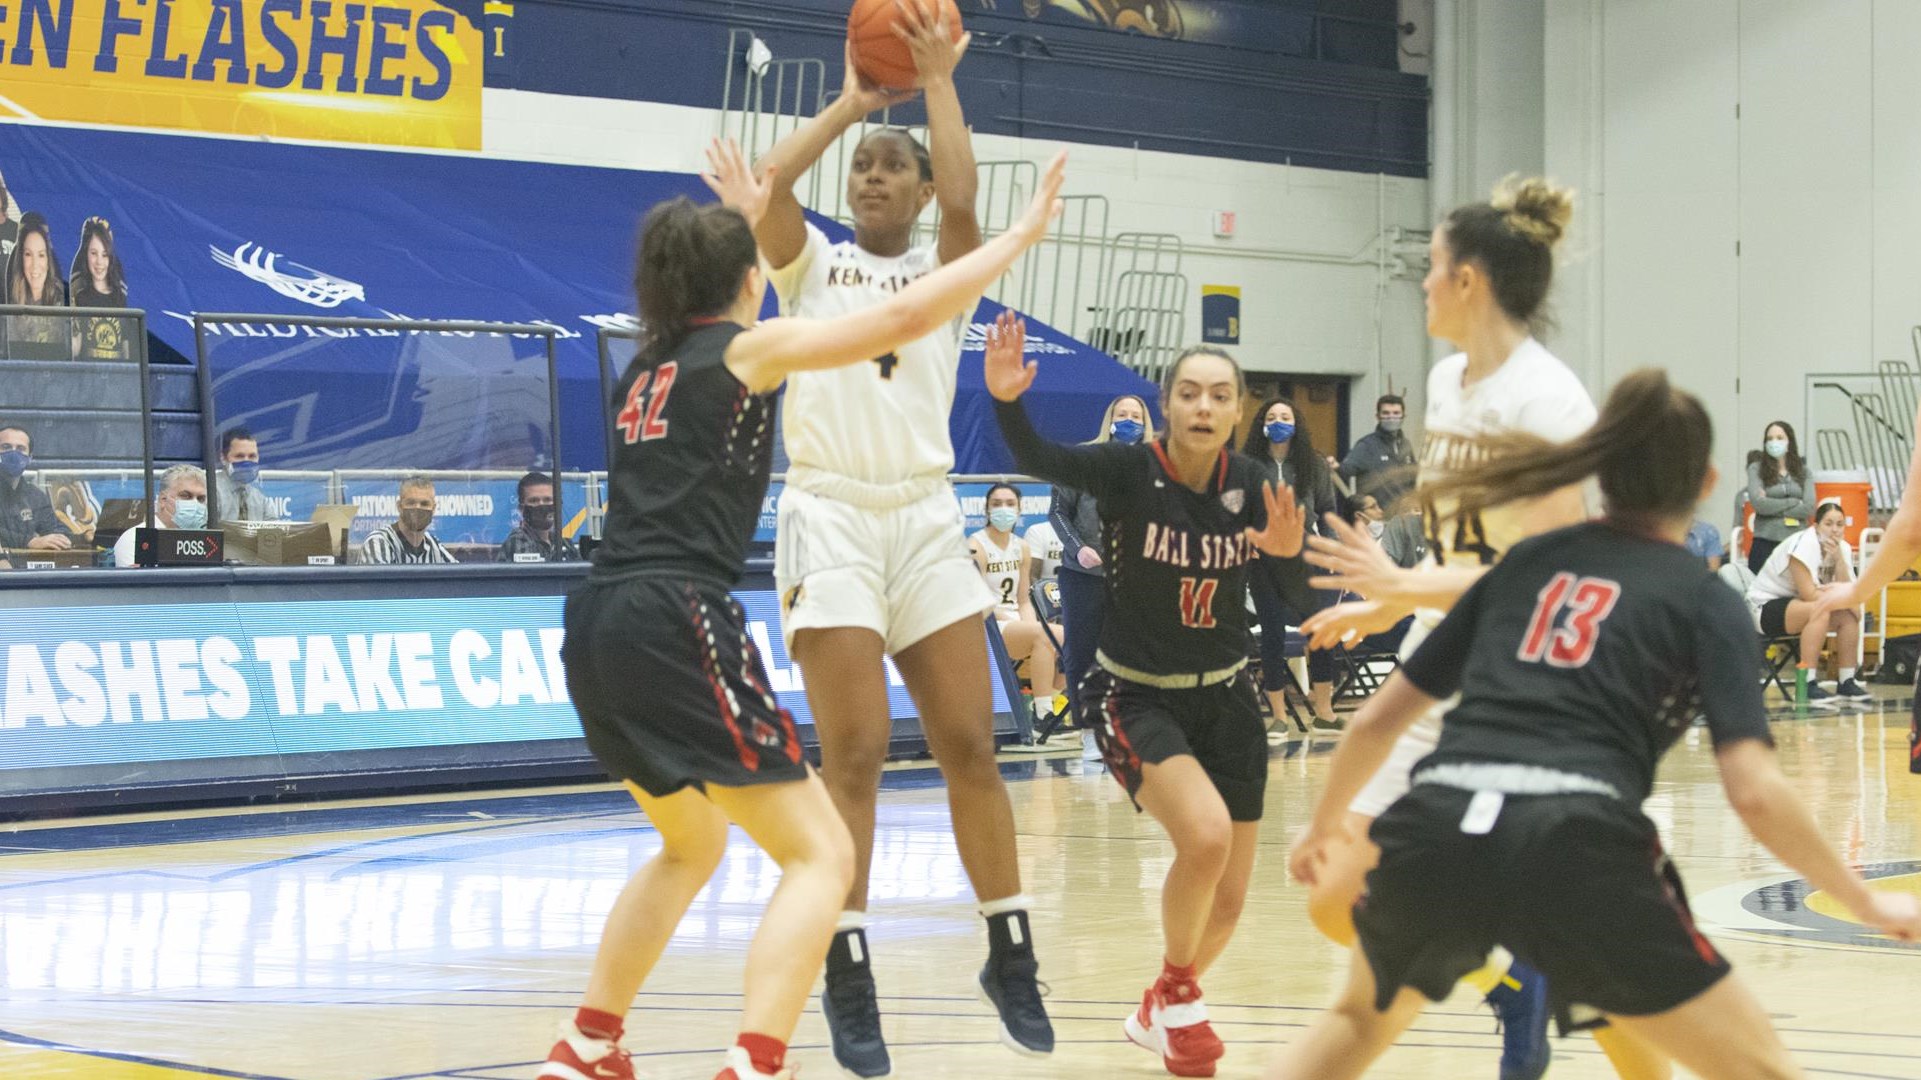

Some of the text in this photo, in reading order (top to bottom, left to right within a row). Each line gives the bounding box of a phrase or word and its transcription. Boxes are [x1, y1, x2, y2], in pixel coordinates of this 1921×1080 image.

[0, 0, 456, 101] N FLASHES
[616, 360, 678, 445] 42
[433, 494, 494, 517] ENOWNED
[176, 540, 206, 556] POSS.
[1142, 521, 1190, 568] BALL
[1001, 577, 1015, 605] 2
[1179, 577, 1219, 629] 11
[1517, 570, 1622, 668] 13
[0, 634, 250, 729] ASHES
[253, 632, 444, 716] TAKE
